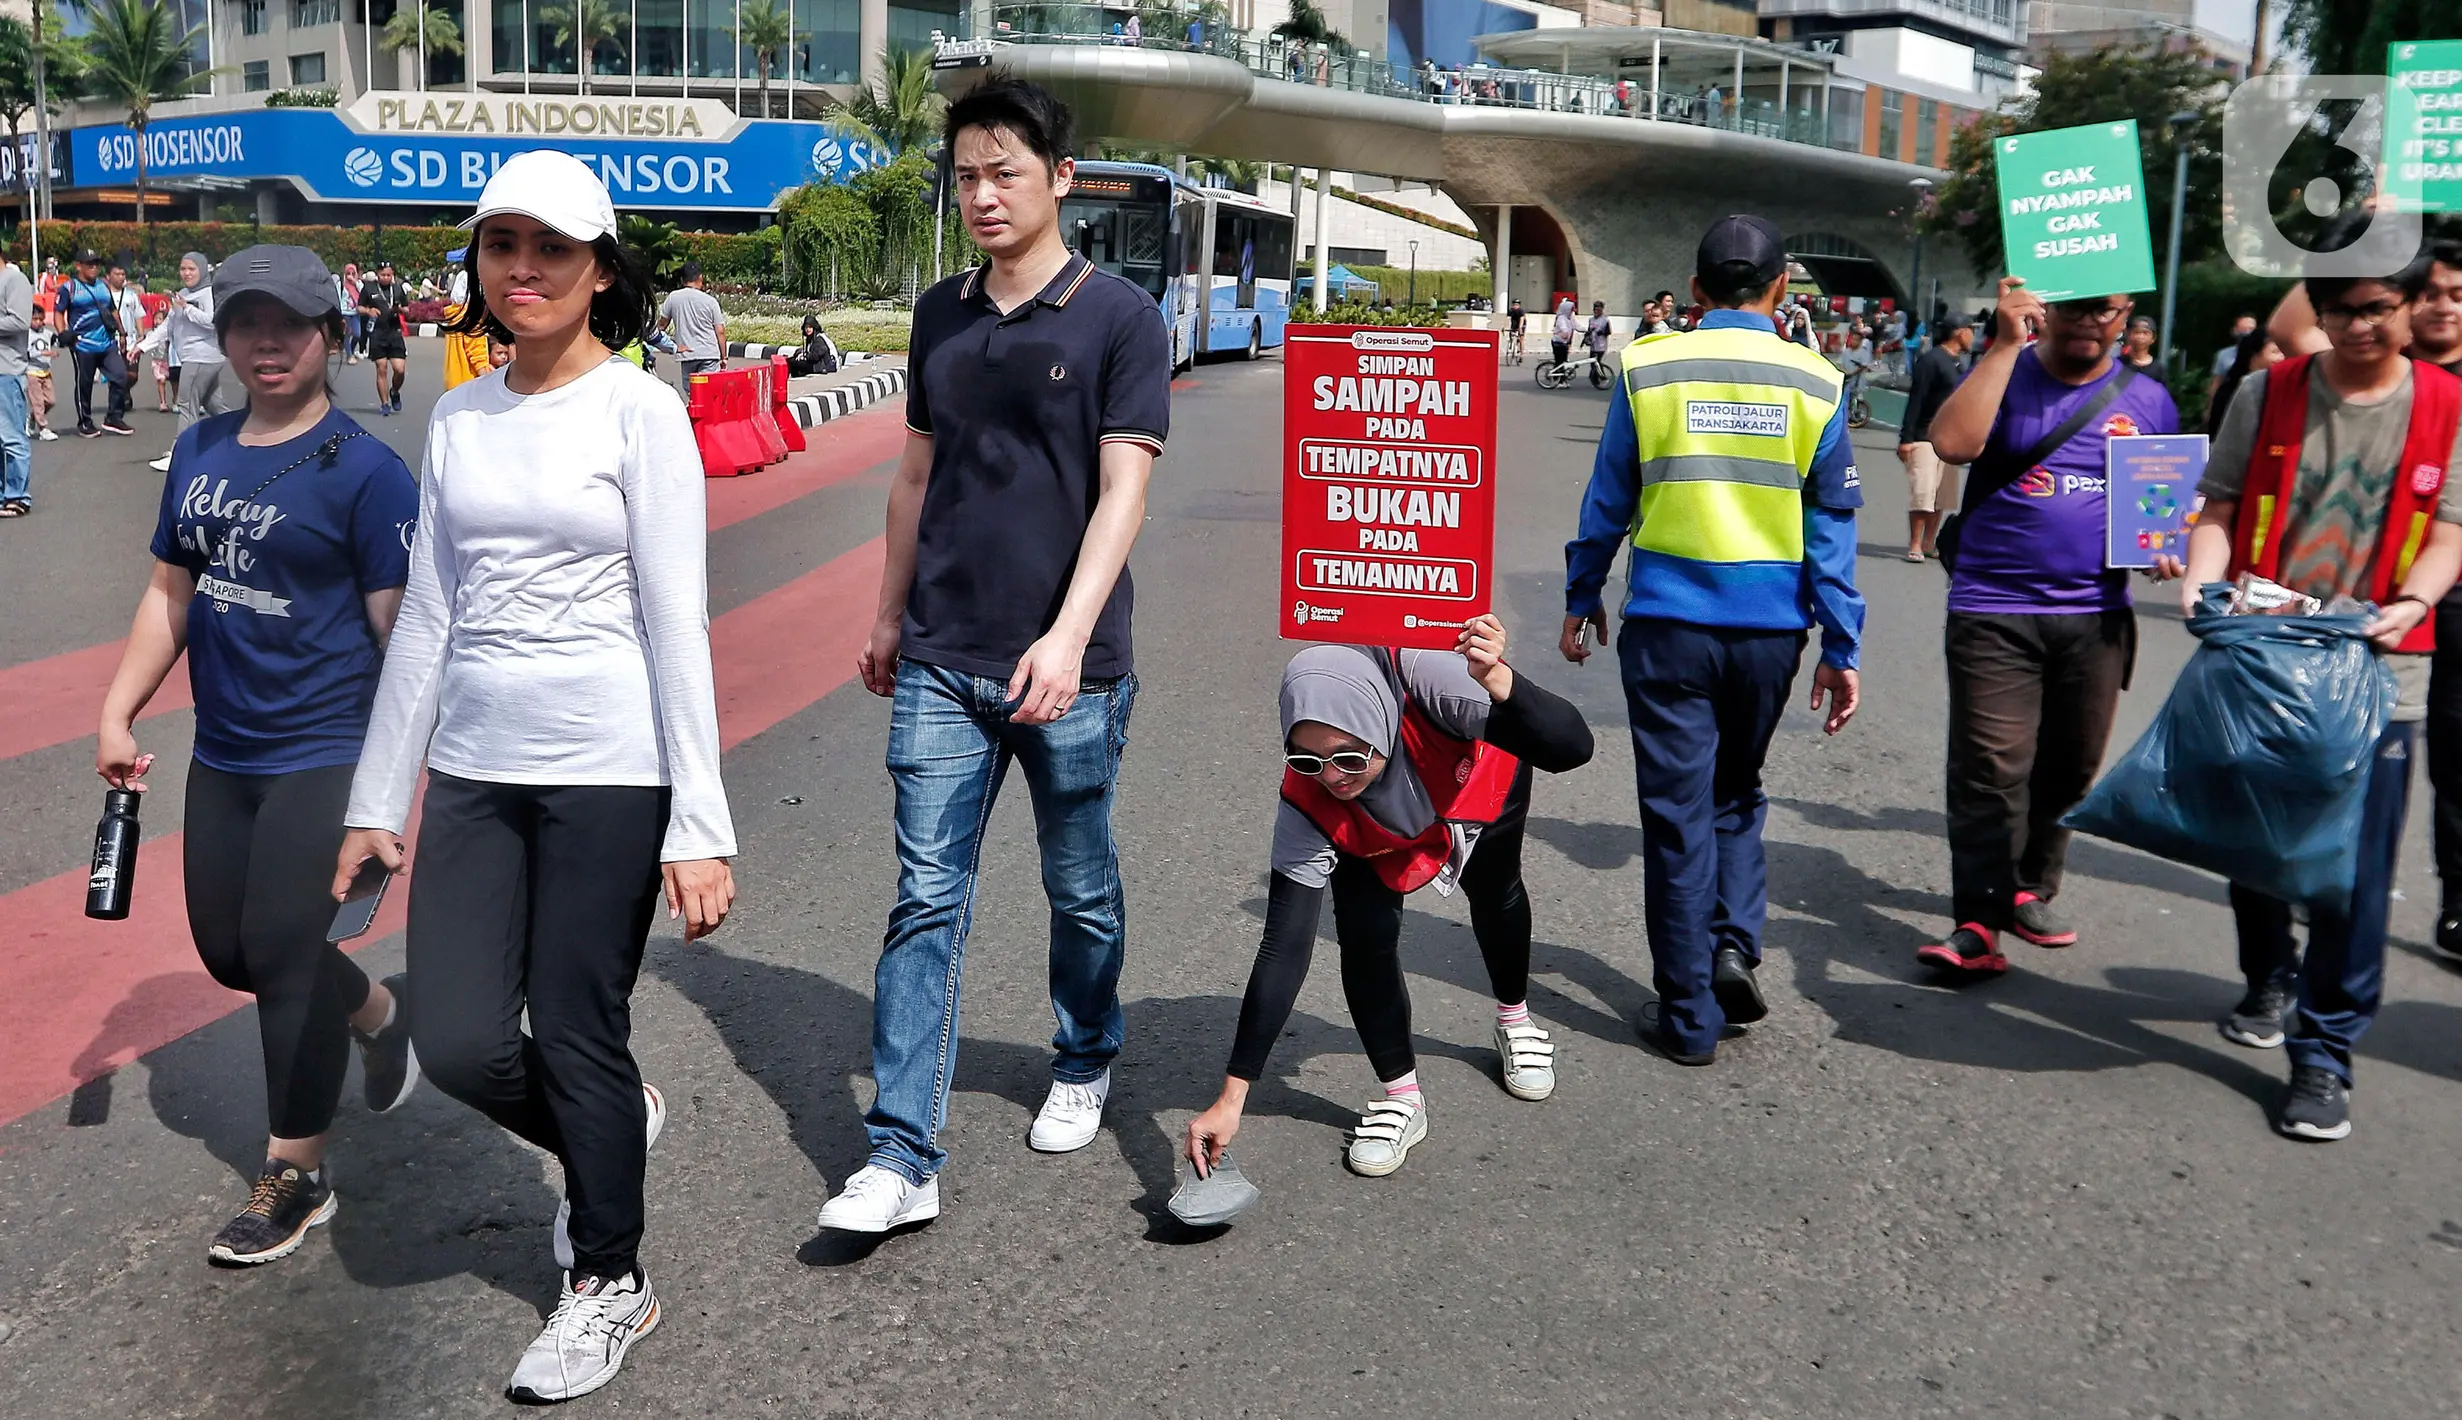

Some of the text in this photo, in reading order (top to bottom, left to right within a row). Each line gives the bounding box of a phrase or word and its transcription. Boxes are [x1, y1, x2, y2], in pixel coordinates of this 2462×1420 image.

[2397, 69, 2462, 88] KEEP
[378, 98, 703, 137] PLAZA INDONESIA
[113, 135, 135, 171] SD
[2402, 139, 2450, 158] IT'S
[390, 148, 733, 194] SD BINSOR
[2042, 165, 2096, 188] GAK
[2010, 184, 2133, 216] NYAMPAH
[2047, 211, 2102, 234] GAK
[2033, 232, 2118, 258] SUSAH
[1366, 336, 1429, 346] Operasi Semut
[1358, 355, 1434, 377] SIMPAN
[1312, 375, 1471, 417] SAMPAH
[1691, 405, 1783, 418] PATROLI JALUR
[1366, 417, 1427, 440] PADA
[1690, 418, 1783, 432] TRANSJAKARTA
[1306, 445, 1469, 481] TEMPATNYA
[179, 473, 287, 541] Relay
[1327, 485, 1461, 529] BUKAN
[195, 525, 256, 580] Life
[1359, 528, 1419, 553] PADA
[1312, 558, 1460, 594] TEMANNYA
[1310, 605, 1344, 617] Operasi
[1310, 614, 1338, 623] Semut
